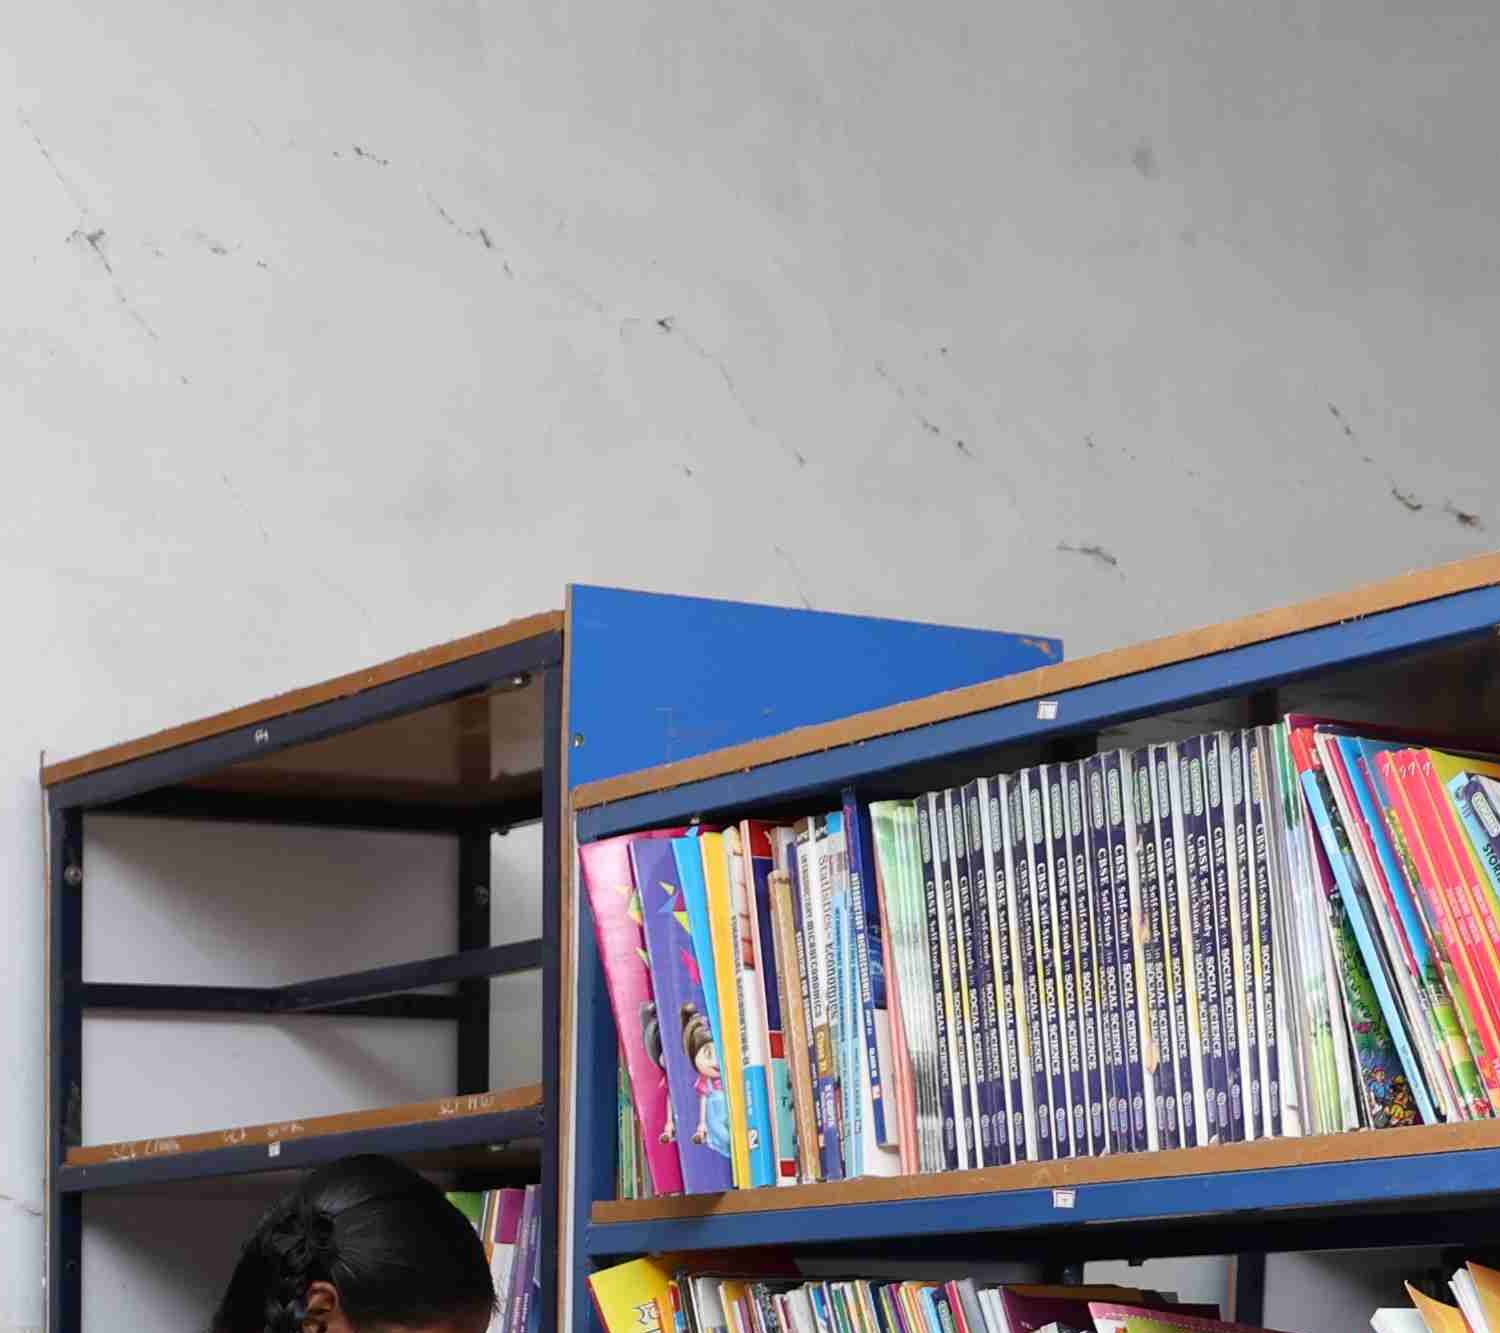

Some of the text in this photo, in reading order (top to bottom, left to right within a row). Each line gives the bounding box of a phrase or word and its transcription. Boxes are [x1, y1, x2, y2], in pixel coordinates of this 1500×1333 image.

[1098, 848, 1108, 889] CBSE
[1114, 844, 1126, 885] CBSE
[1163, 837, 1175, 877] CBSE
[1213, 827, 1224, 868] CBSE
[1118, 886, 1130, 945] Self-Study
[1106, 966, 1117, 1010] SOCIAL
[1122, 963, 1133, 1008] SOCIAL
[1173, 958, 1183, 1003] SOCIAL
[1222, 948, 1233, 994] SOCIAL
[1065, 974, 1075, 1020] SOCIAL
[1068, 1020, 1079, 1072] SCIENCE
[1111, 1012, 1122, 1066] SCIENCE
[1126, 1010, 1138, 1063] SCIENCE
[1175, 1004, 1187, 1059] SCIENCE
[1225, 995, 1236, 1051] SCIENCE
